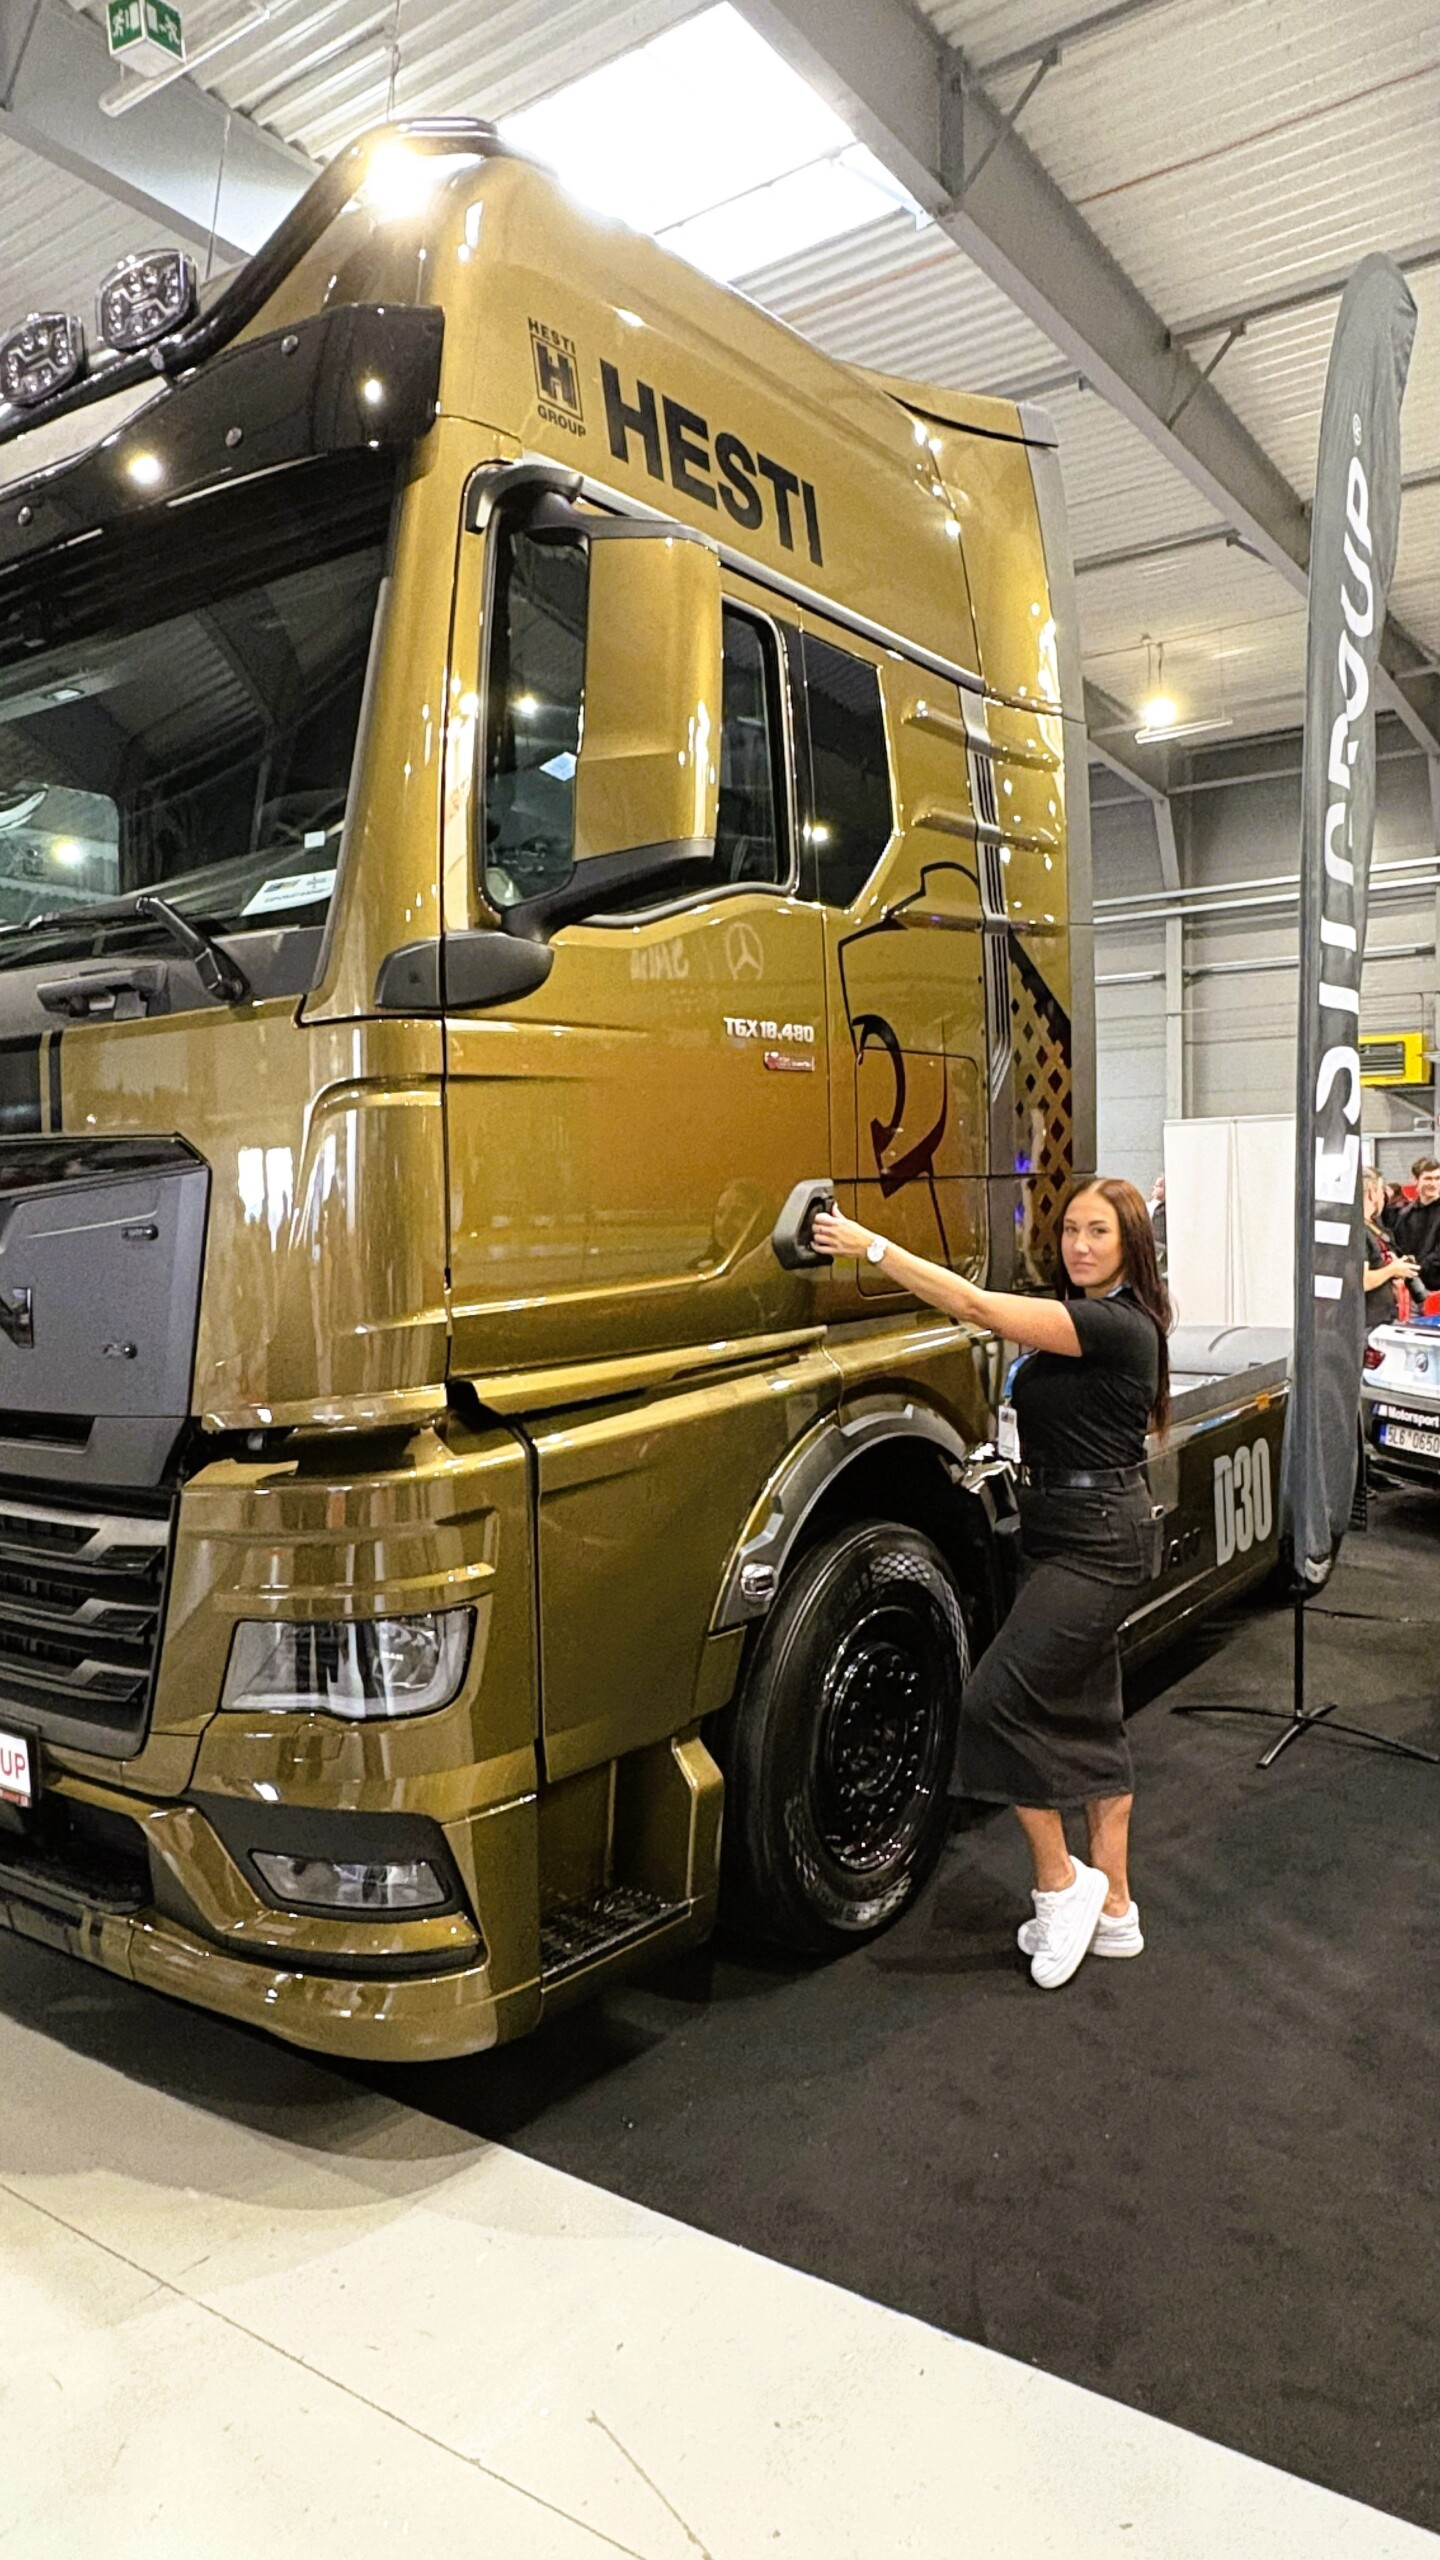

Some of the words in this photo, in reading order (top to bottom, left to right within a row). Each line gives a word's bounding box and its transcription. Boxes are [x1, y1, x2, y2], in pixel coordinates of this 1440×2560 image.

[528, 316, 576, 355] HESTI
[537, 404, 586, 438] GROUP
[600, 357, 823, 567] HESTI
[1388, 1406, 1440, 1428] Motorsport
[1213, 1437, 1272, 1567] D30
